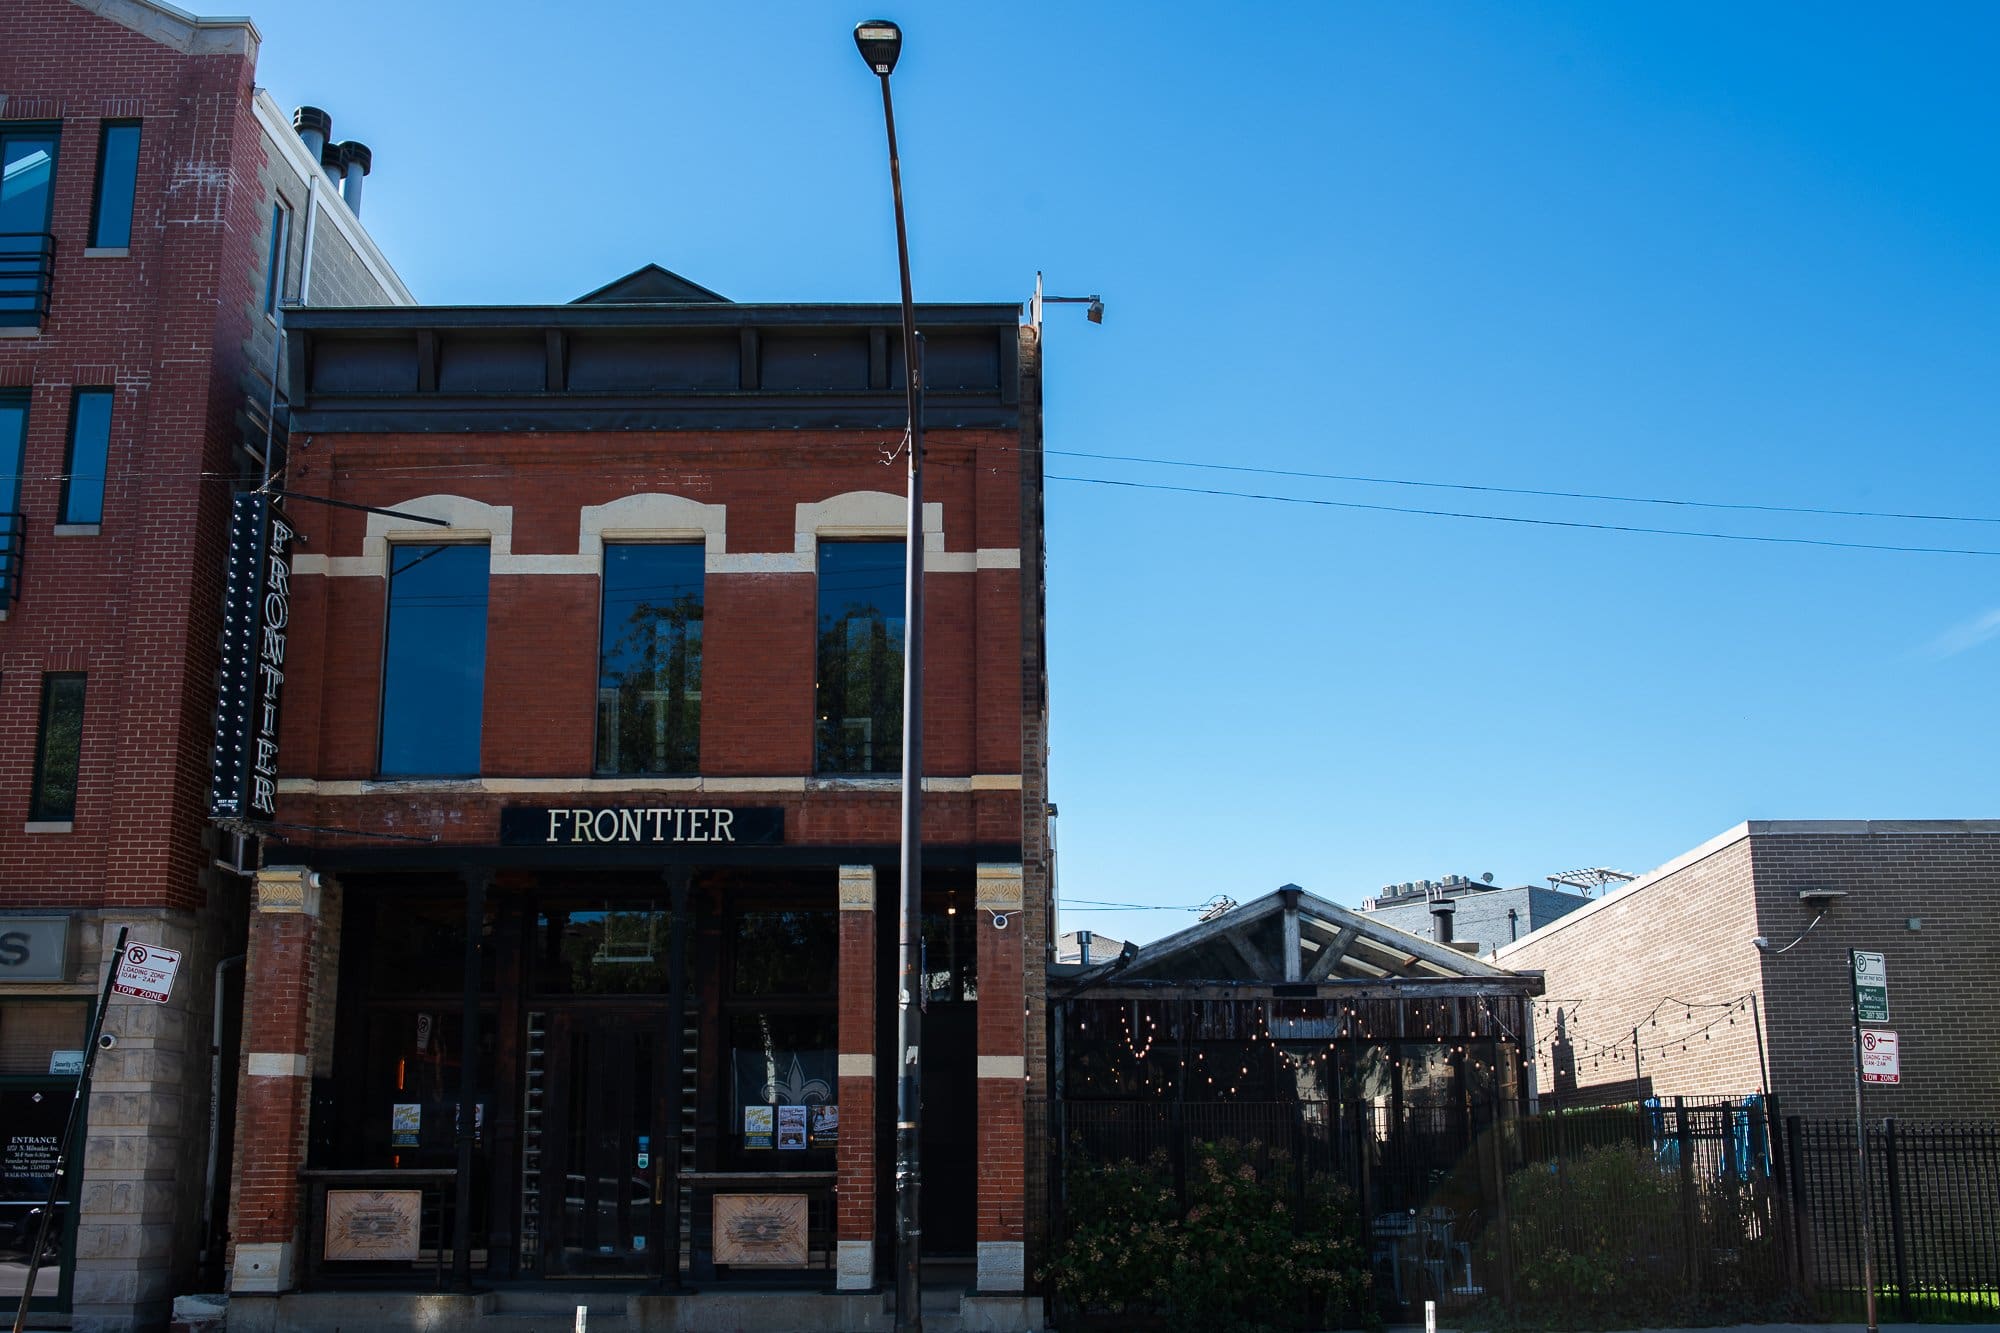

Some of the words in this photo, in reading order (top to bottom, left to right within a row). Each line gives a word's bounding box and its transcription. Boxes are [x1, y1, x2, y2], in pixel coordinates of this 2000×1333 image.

[252, 519, 294, 814] FRONTIER
[546, 808, 736, 842] FRONTIER
[122, 966, 148, 976] LOADING
[150, 972, 166, 980] ZONE
[117, 985, 136, 995] TOW
[139, 990, 163, 1001] ZONE
[11, 1136, 57, 1144] ENTRANCE
